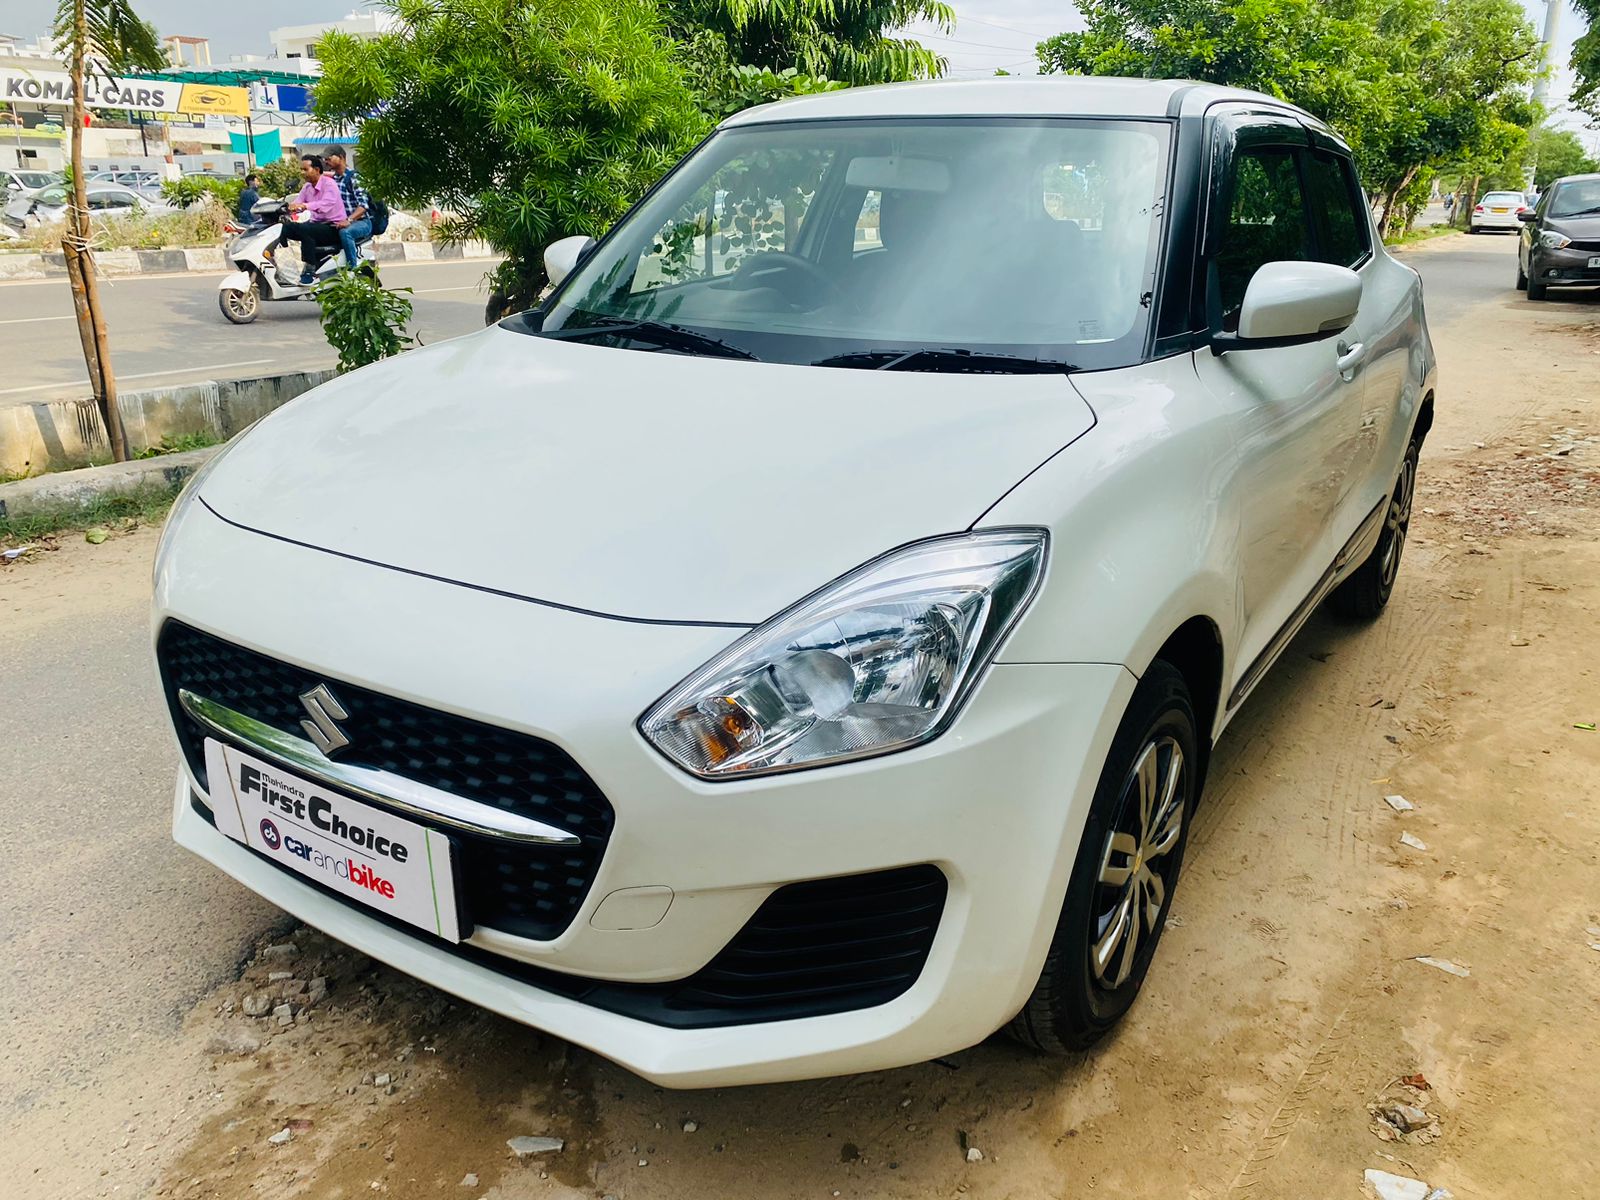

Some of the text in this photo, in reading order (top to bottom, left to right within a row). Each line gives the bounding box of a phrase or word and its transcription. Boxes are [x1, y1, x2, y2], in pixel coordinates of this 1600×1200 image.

[6, 77, 165, 107] KOMAL CARS
[240, 762, 409, 864] First Choice
